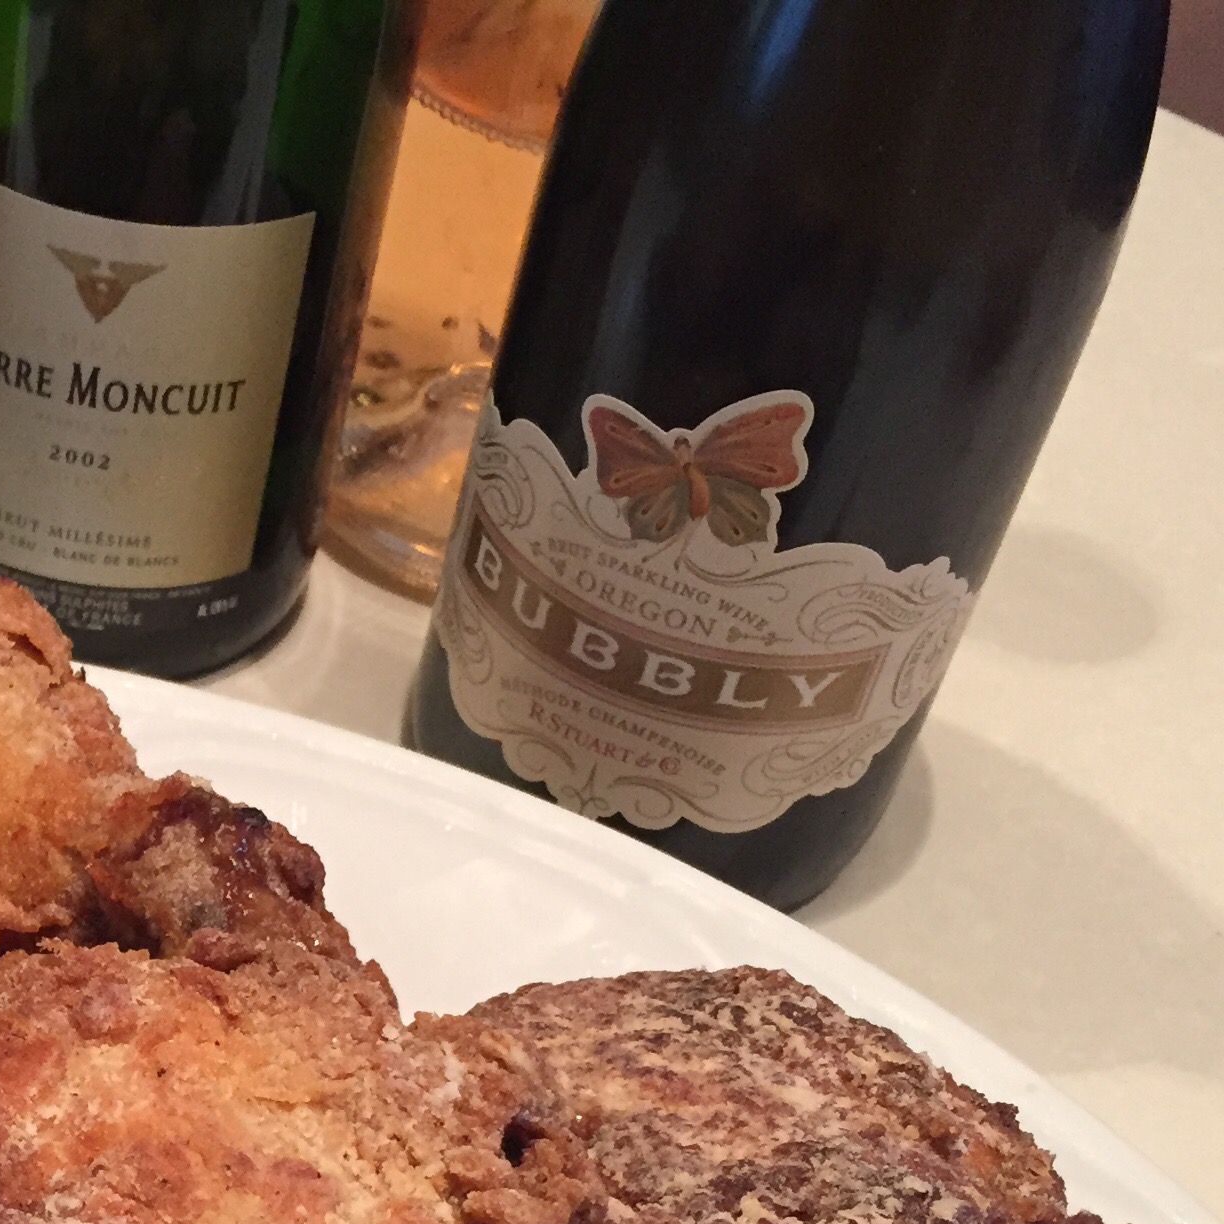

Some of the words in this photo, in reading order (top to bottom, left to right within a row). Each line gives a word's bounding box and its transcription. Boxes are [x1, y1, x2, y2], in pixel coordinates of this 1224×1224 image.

[65, 360, 246, 417] MONCUIT
[48, 444, 112, 472] 2002
[473, 534, 846, 710] BUBBLY
[576, 569, 718, 638] OREGON
[596, 551, 712, 605] SPARKLING
[717, 598, 770, 631] WINE
[588, 706, 727, 777] CHAMPENOISE
